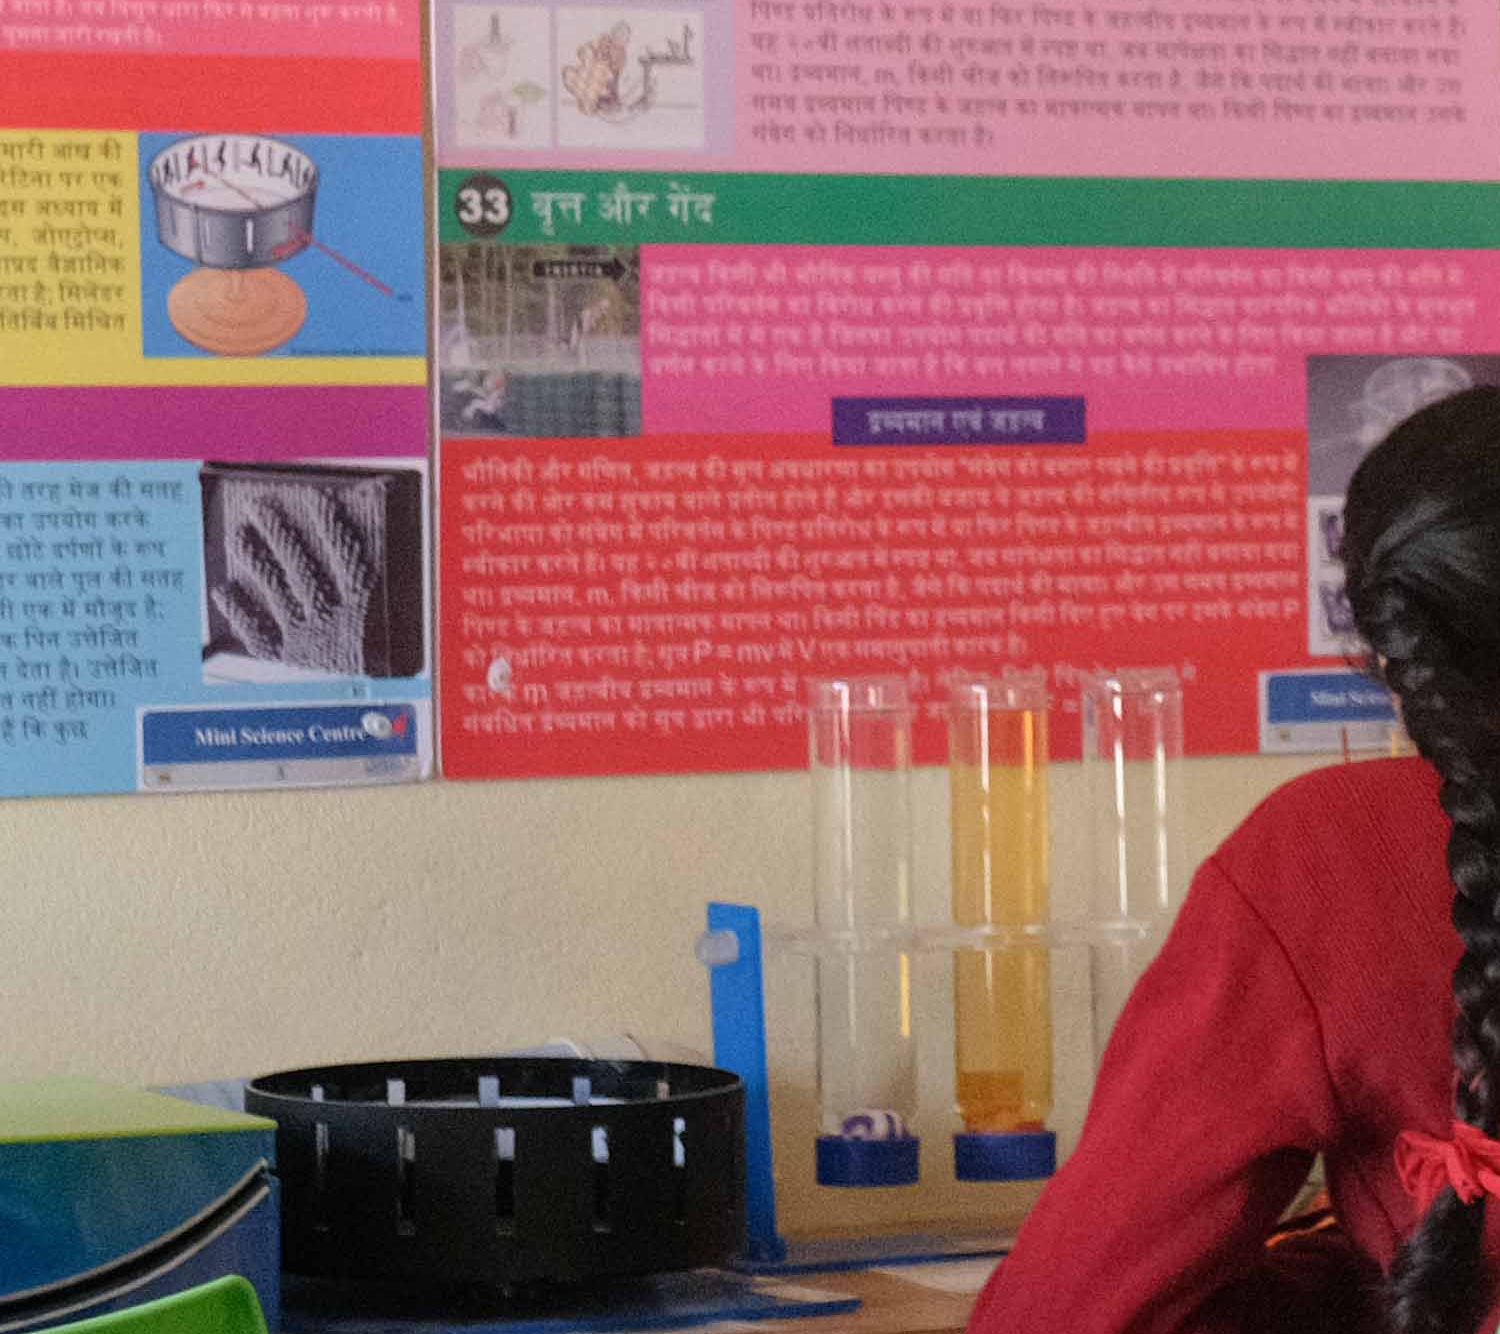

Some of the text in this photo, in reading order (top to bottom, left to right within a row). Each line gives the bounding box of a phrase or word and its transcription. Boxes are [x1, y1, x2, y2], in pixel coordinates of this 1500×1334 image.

[458, 189, 509, 223] 33
[601, 181, 655, 223] और
[670, 183, 715, 223] गेंद
[195, 727, 236, 747] Mini
[239, 724, 303, 748] Science
